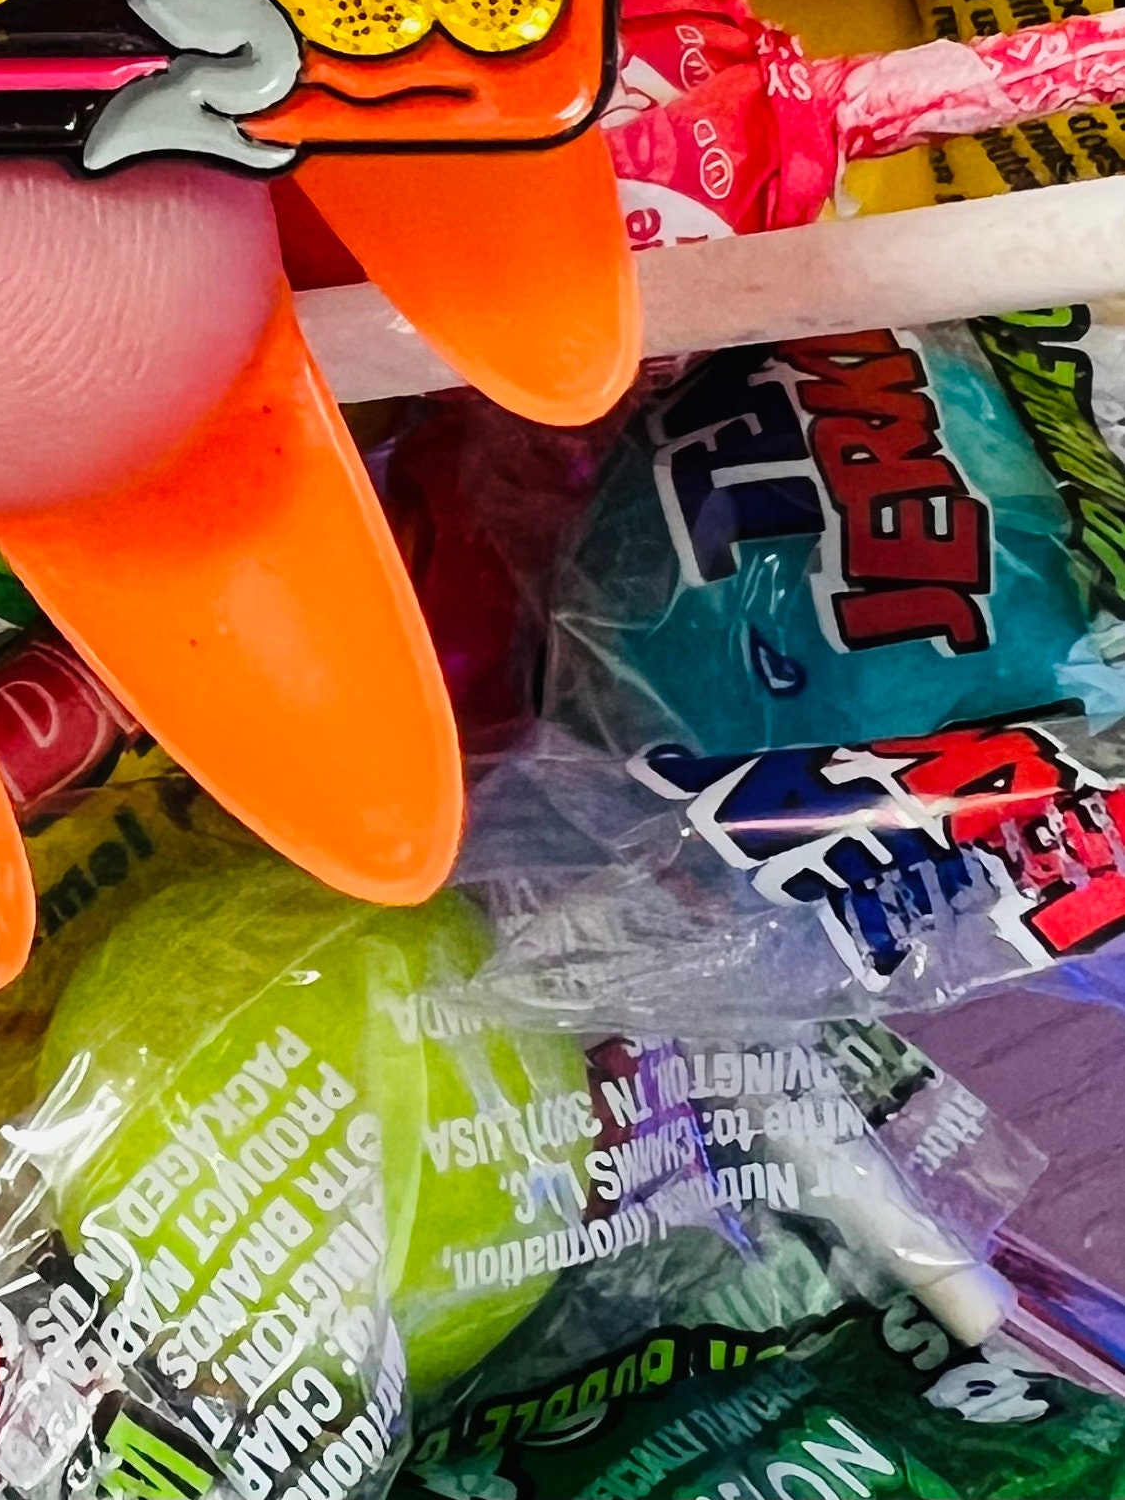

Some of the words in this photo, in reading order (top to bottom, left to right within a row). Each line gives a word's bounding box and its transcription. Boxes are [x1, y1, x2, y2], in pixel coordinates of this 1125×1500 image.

[116, 1025, 312, 1238] PACKAGED
[177, 1061, 357, 1266] PRODUCT
[421, 1113, 504, 1174] USA
[600, 1070, 654, 1129] TN
[73, 1238, 132, 1297] IN
[157, 1195, 313, 1390] BRANDS
